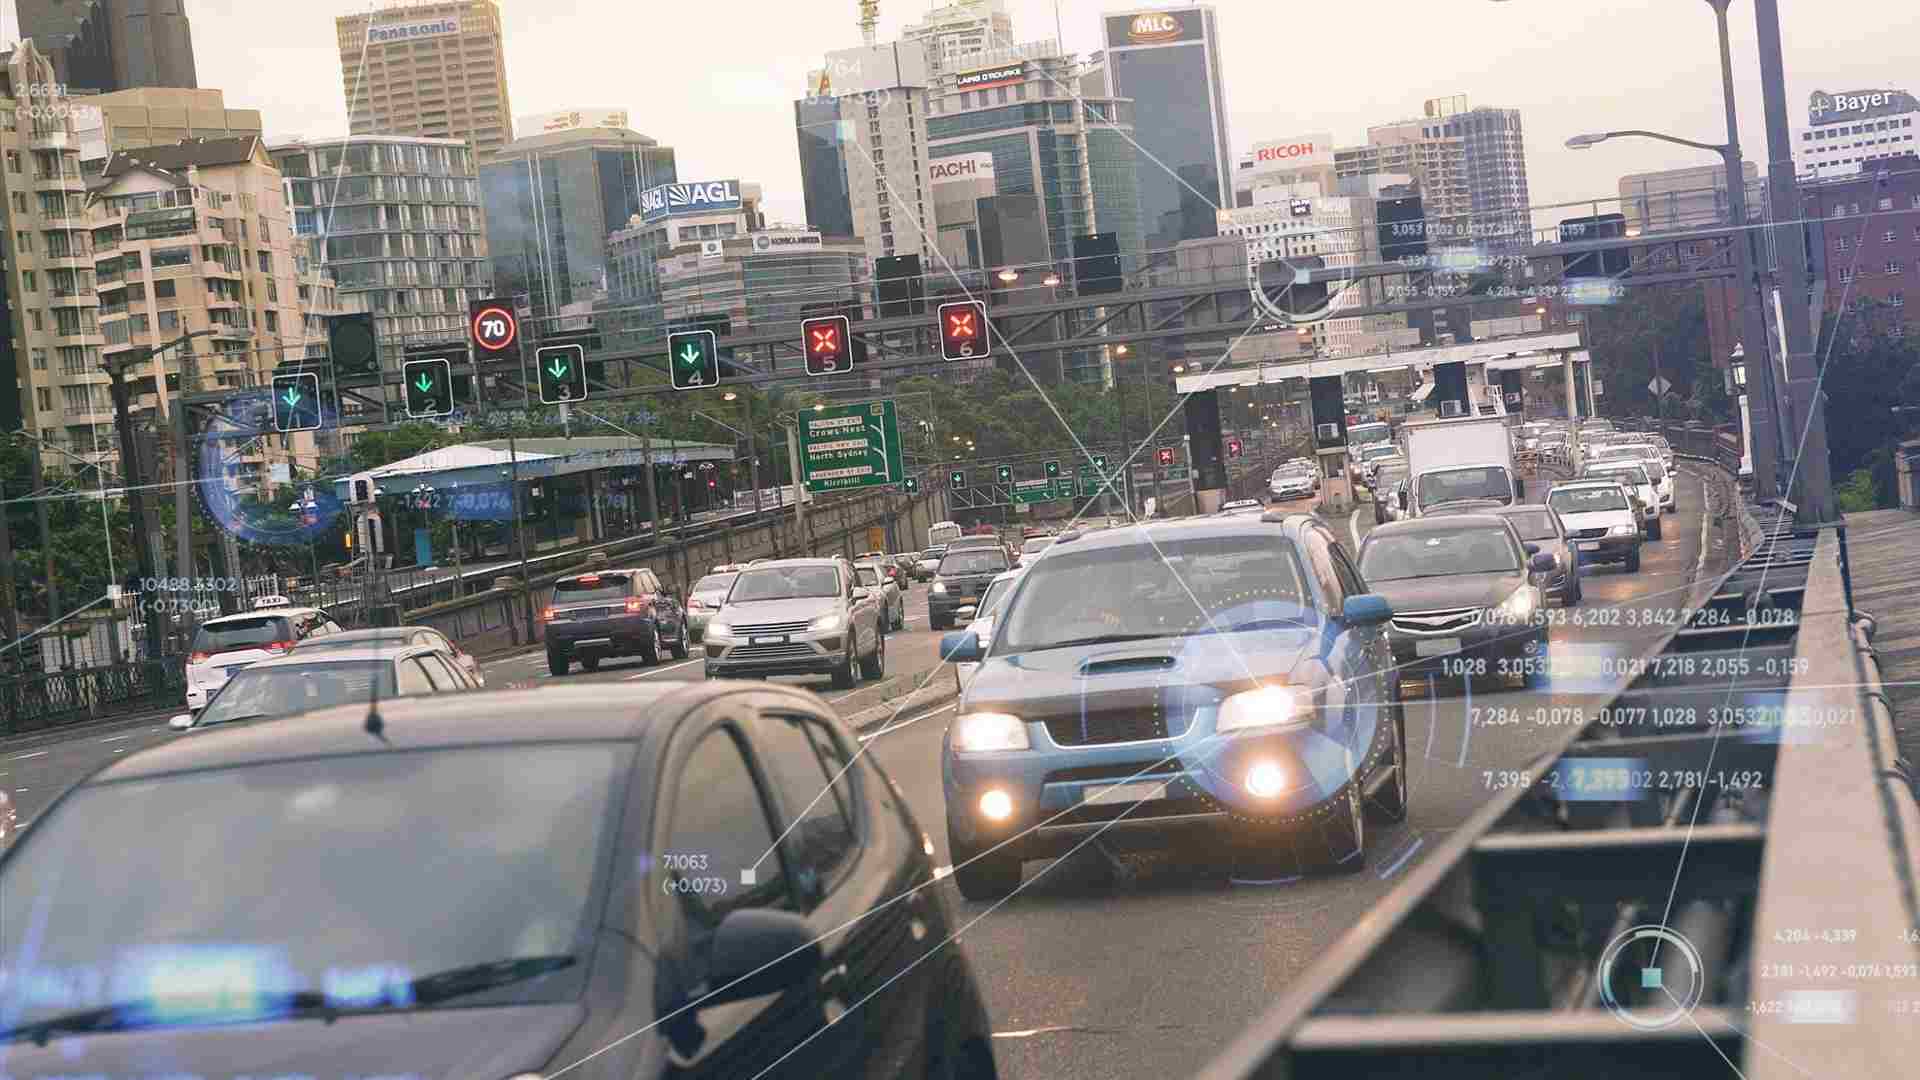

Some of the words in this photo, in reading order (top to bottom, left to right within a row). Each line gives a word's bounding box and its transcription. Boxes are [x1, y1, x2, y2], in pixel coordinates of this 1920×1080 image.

[368, 20, 457, 42] Panasonic
[1135, 15, 1175, 33] MLC
[1833, 93, 1892, 112] Bayer
[1257, 143, 1312, 161] RICOH
[692, 182, 739, 204] AGL
[481, 320, 505, 338] 70
[959, 341, 974, 357] 6
[823, 355, 837, 371] 5
[687, 370, 703, 385] 4
[559, 384, 571, 400] 3
[424, 398, 437, 412] 2
[809, 428, 840, 437] Crows
[809, 451, 834, 461] North
[837, 449, 868, 459] Sydney
